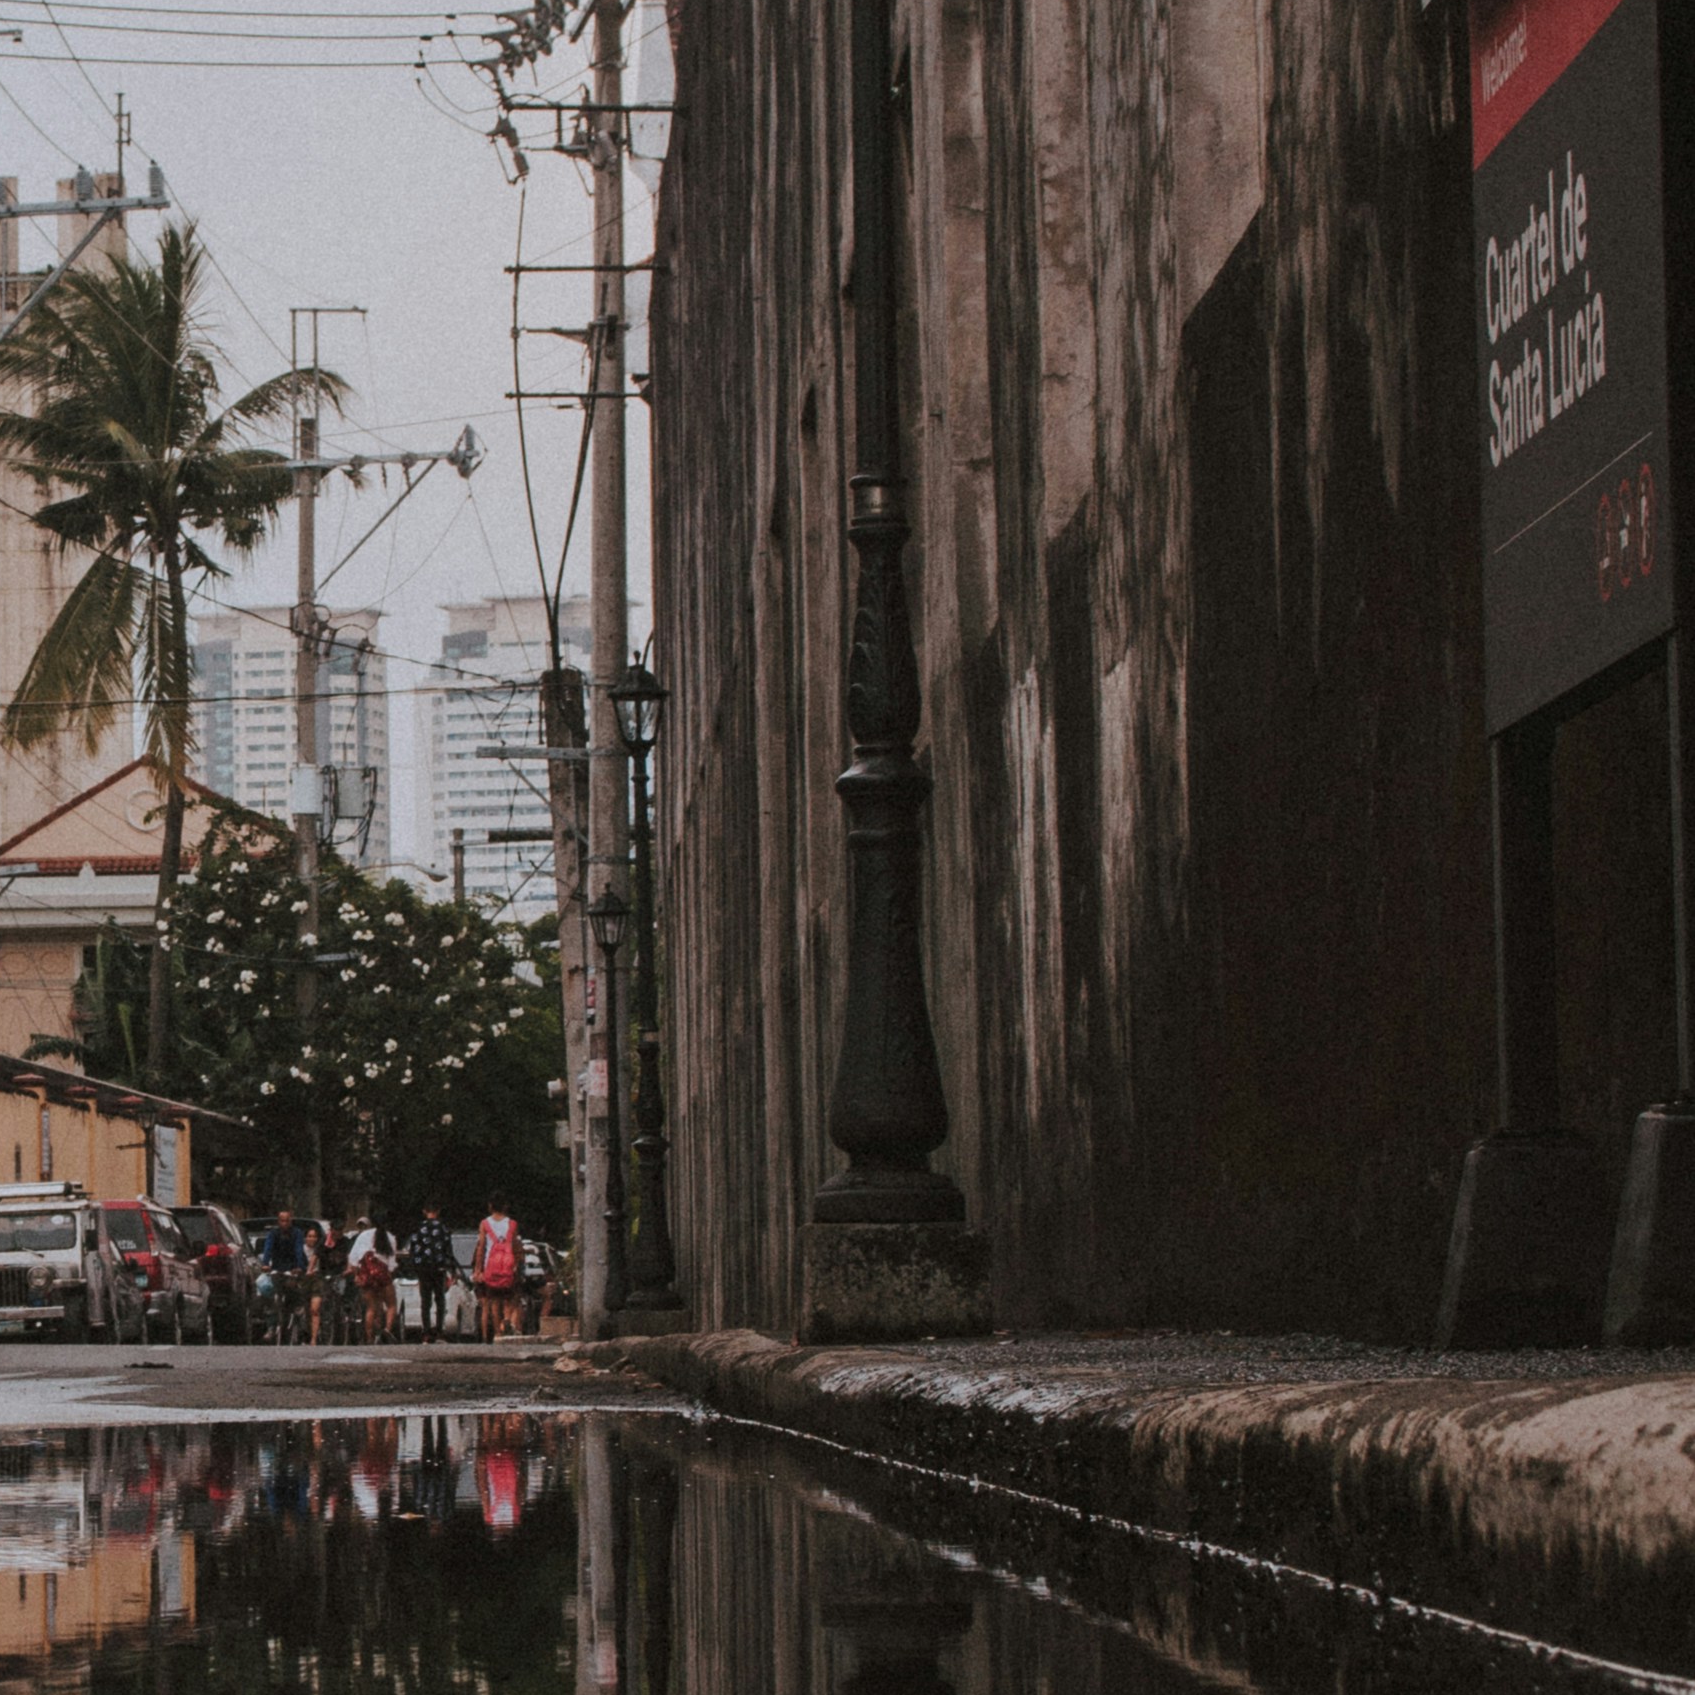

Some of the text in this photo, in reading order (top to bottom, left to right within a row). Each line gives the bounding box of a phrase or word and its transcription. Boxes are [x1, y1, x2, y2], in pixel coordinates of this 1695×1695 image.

[1486, 150, 1588, 345] Cuartel de
[1489, 270, 1606, 468] Santa Lucía
